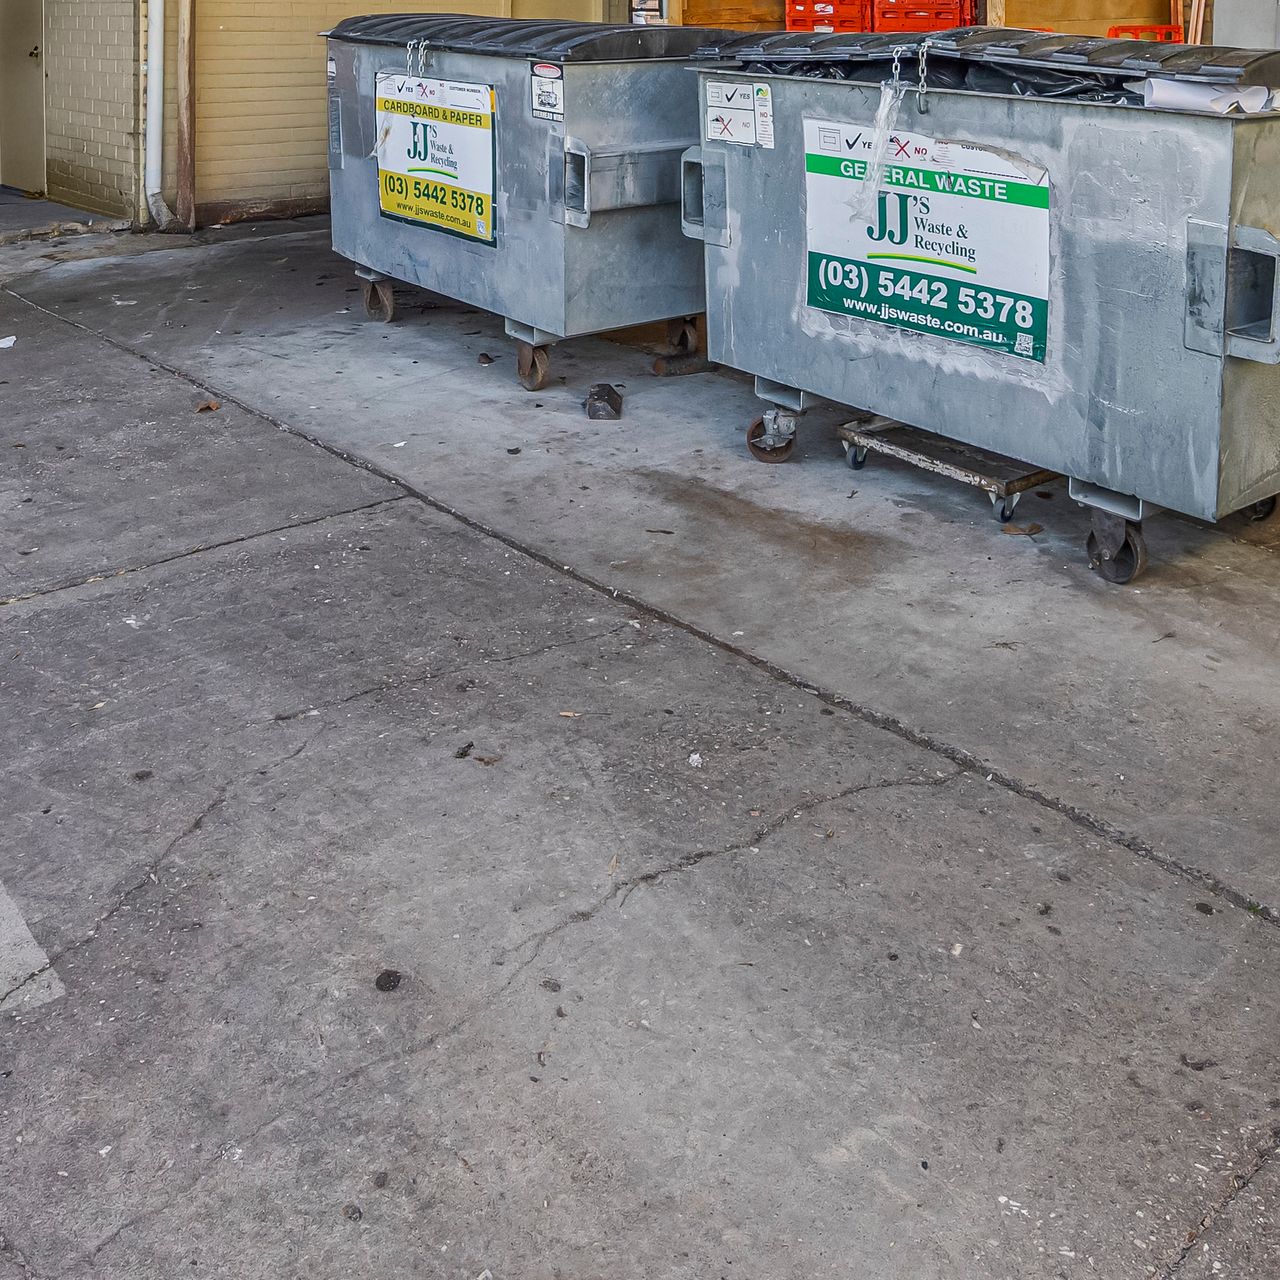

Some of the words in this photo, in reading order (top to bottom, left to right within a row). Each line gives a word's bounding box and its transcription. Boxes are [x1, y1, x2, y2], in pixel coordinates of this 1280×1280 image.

[383, 100, 440, 119] CARDBOARD
[441, 112, 448, 120] &
[450, 113, 483, 126] PAPER
[430, 140, 448, 153] Waste
[447, 144, 454, 155] &
[914, 147, 928, 156] NO
[430, 153, 458, 171] Recycling
[840, 160, 931, 189] GEERAL
[934, 174, 1008, 200] WASTE
[384, 173, 409, 200] (03)
[413, 180, 447, 206] 5442
[451, 190, 484, 217] 5378
[396, 201, 471, 229] www.jjswaste.com.au
[914, 216, 953, 237] Waste
[956, 224, 969, 239] &
[914, 234, 976, 263] Recycling
[818, 259, 869, 298] (03)
[878, 271, 949, 309] 5442
[957, 287, 1034, 329] 5378
[843, 297, 1004, 343] www.jjswaste.com.au
